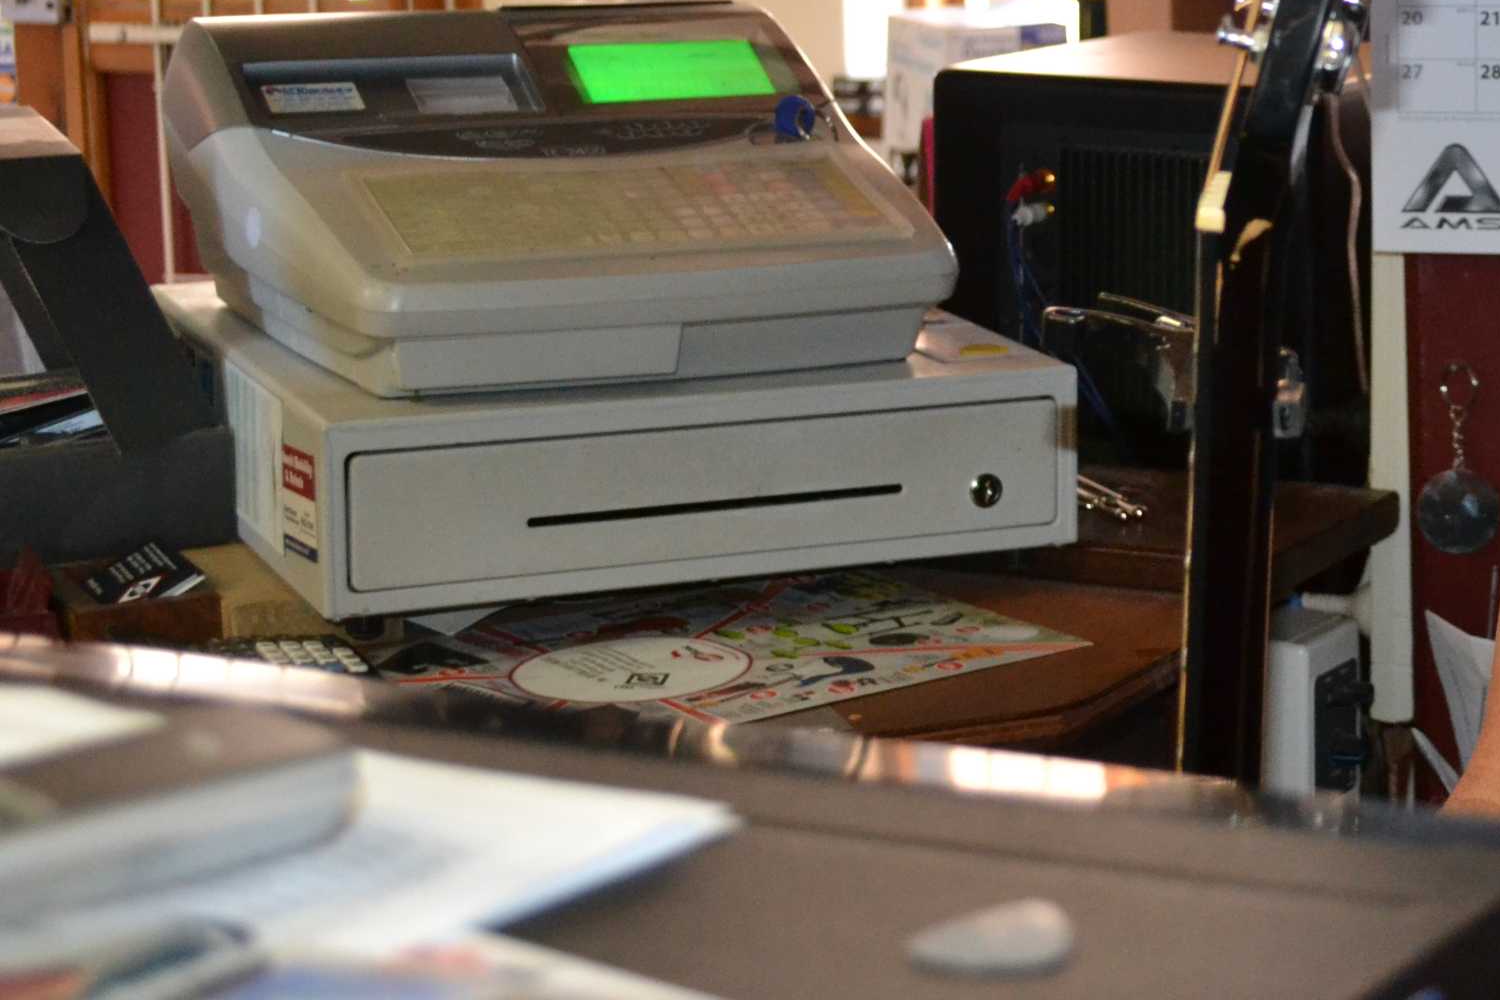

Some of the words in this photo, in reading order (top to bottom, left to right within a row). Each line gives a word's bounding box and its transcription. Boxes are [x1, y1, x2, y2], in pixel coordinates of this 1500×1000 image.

[1401, 11, 1424, 26] 20
[1479, 11, 1500, 26] 21
[1402, 65, 1424, 80] 27
